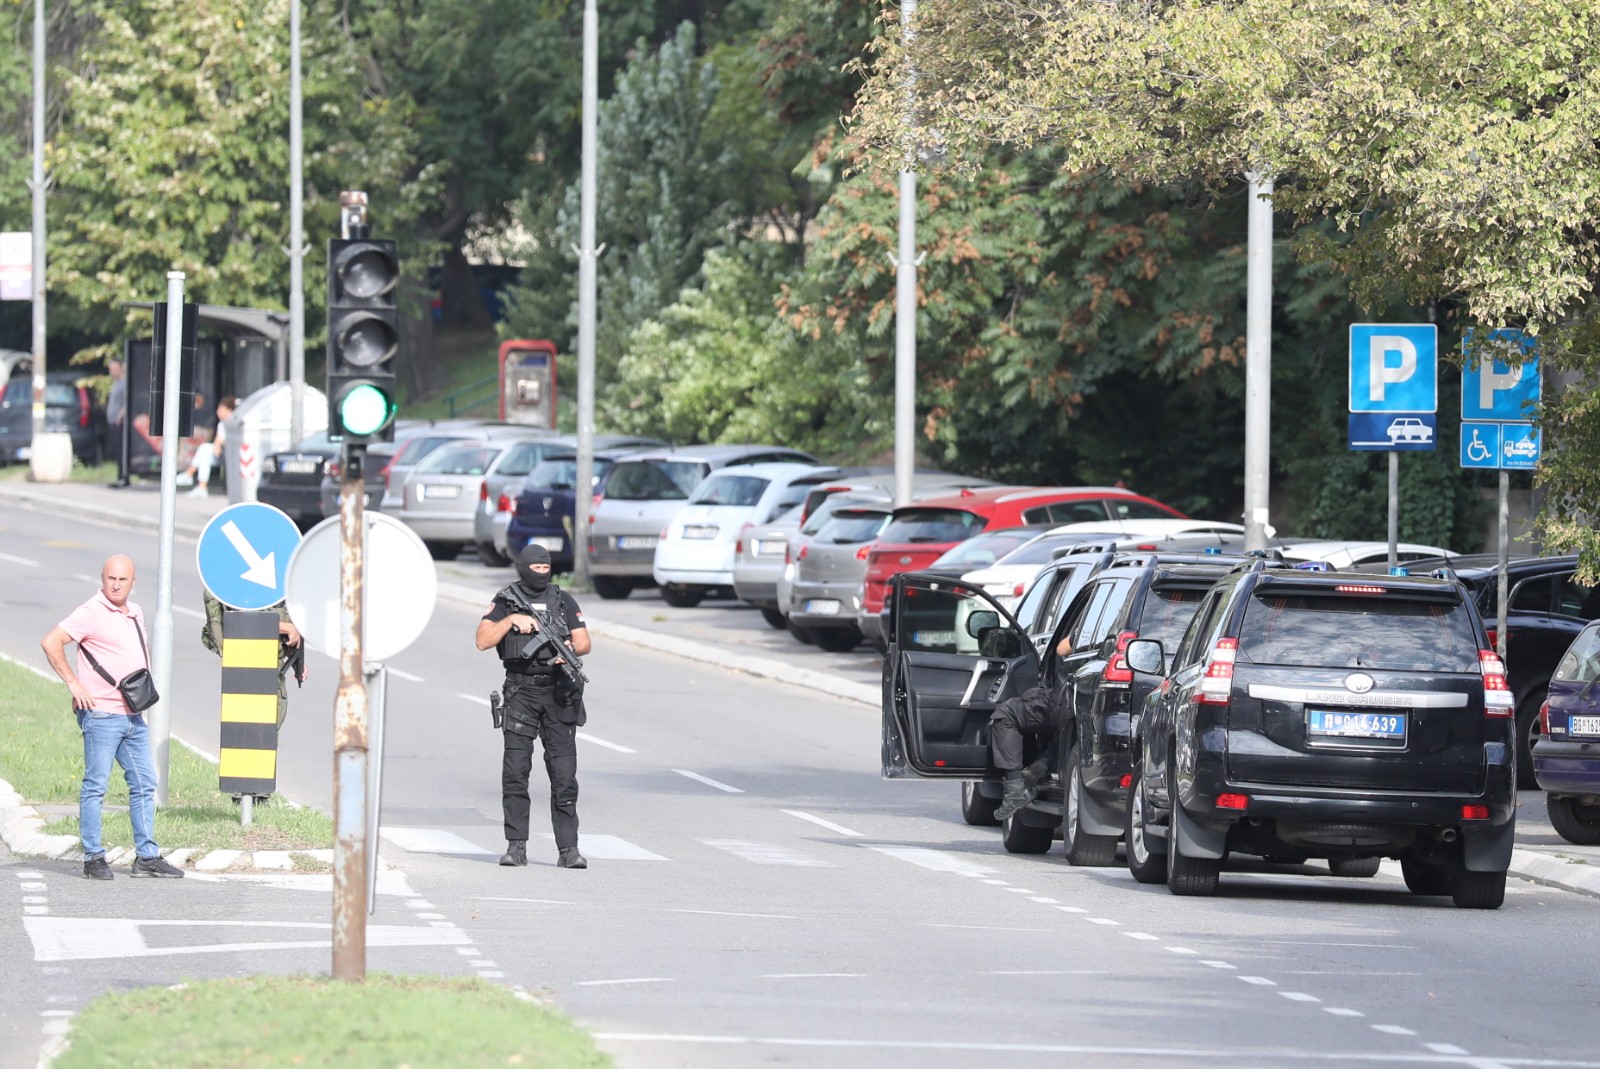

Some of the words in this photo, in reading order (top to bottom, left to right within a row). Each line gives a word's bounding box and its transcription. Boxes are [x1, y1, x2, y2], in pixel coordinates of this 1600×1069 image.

[1369, 335, 1417, 401] P
[1479, 340, 1523, 409] P
[1305, 691, 1344, 703] LAND
[1348, 695, 1413, 705] CRUISER
